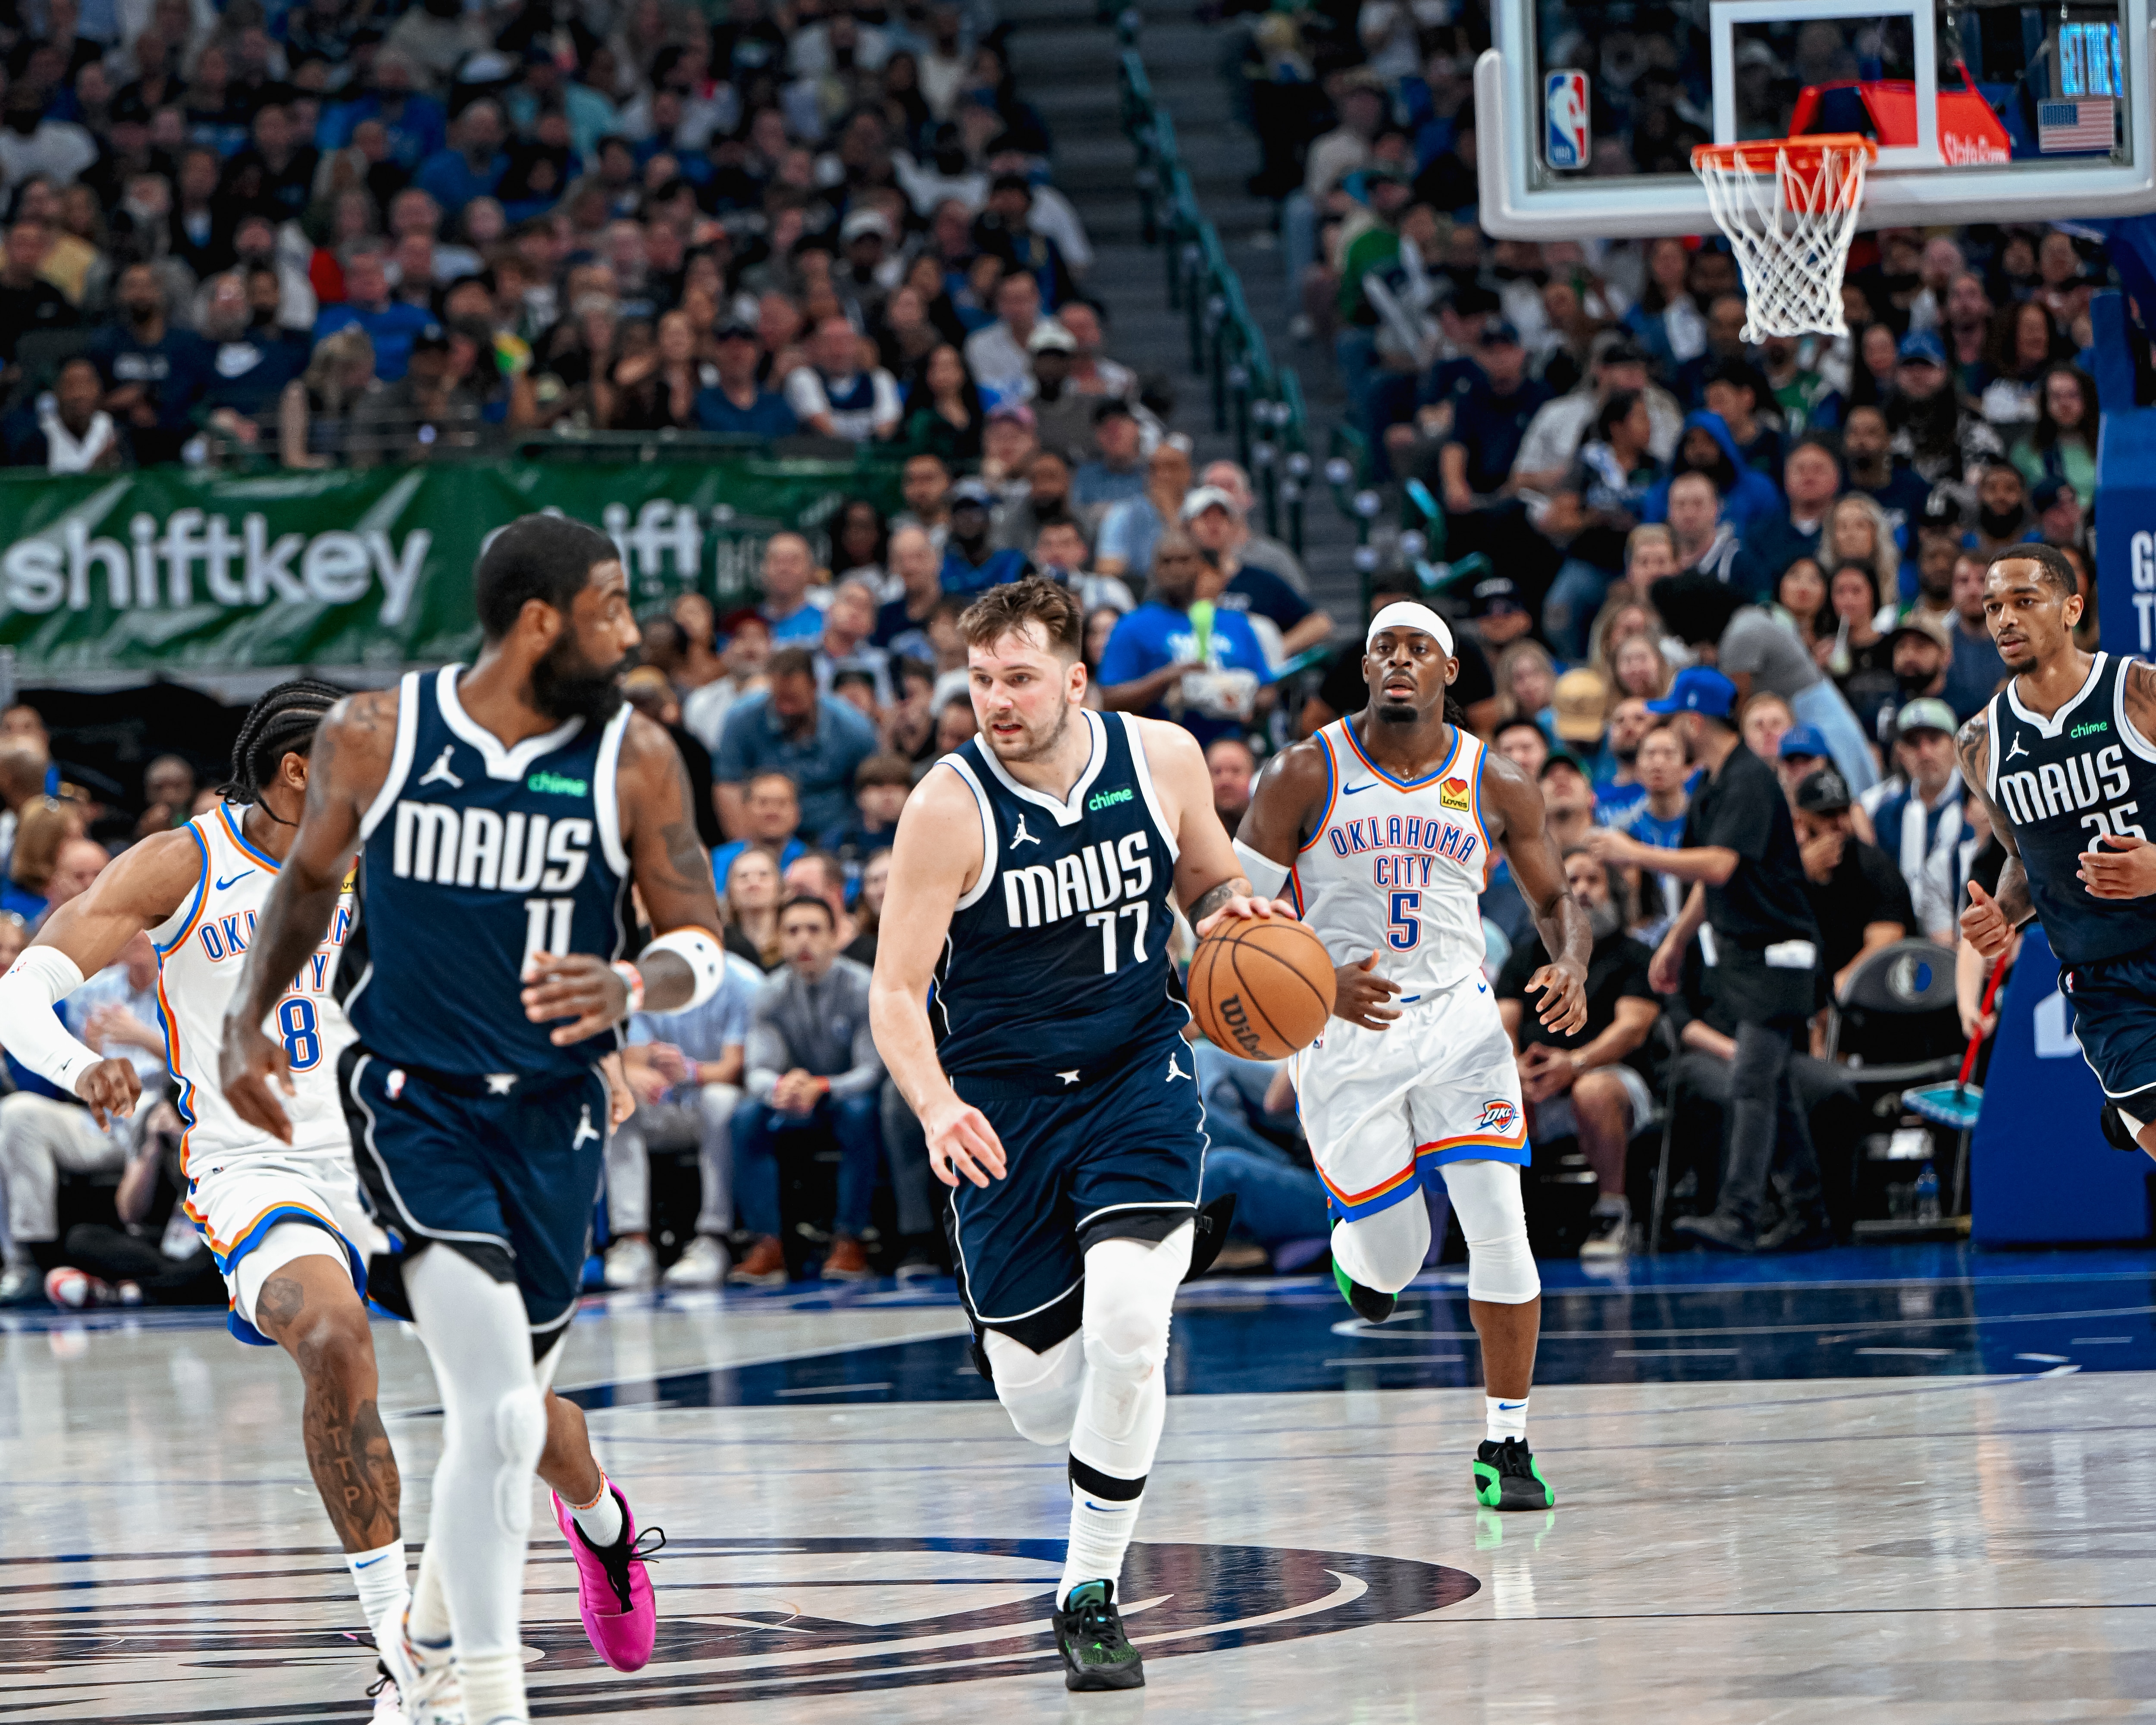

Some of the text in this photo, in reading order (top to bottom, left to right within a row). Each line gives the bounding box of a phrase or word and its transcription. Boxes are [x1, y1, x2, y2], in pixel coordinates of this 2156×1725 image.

[2, 508, 431, 625] shiftkey
[2131, 530, 2156, 592] G
[2132, 592, 2156, 652] T
[2070, 721, 2107, 738] chime
[528, 770, 588, 797] chime
[1089, 787, 1133, 811] chime
[1328, 814, 1478, 866] OKLAHOMA
[2081, 801, 2147, 854] 25
[1374, 855, 1435, 888] CITY
[520, 898, 576, 984] 11
[1085, 900, 1149, 975] 77
[1387, 890, 1422, 953] 5
[276, 995, 323, 1073] 8
[1482, 1107, 1512, 1125] OKC
